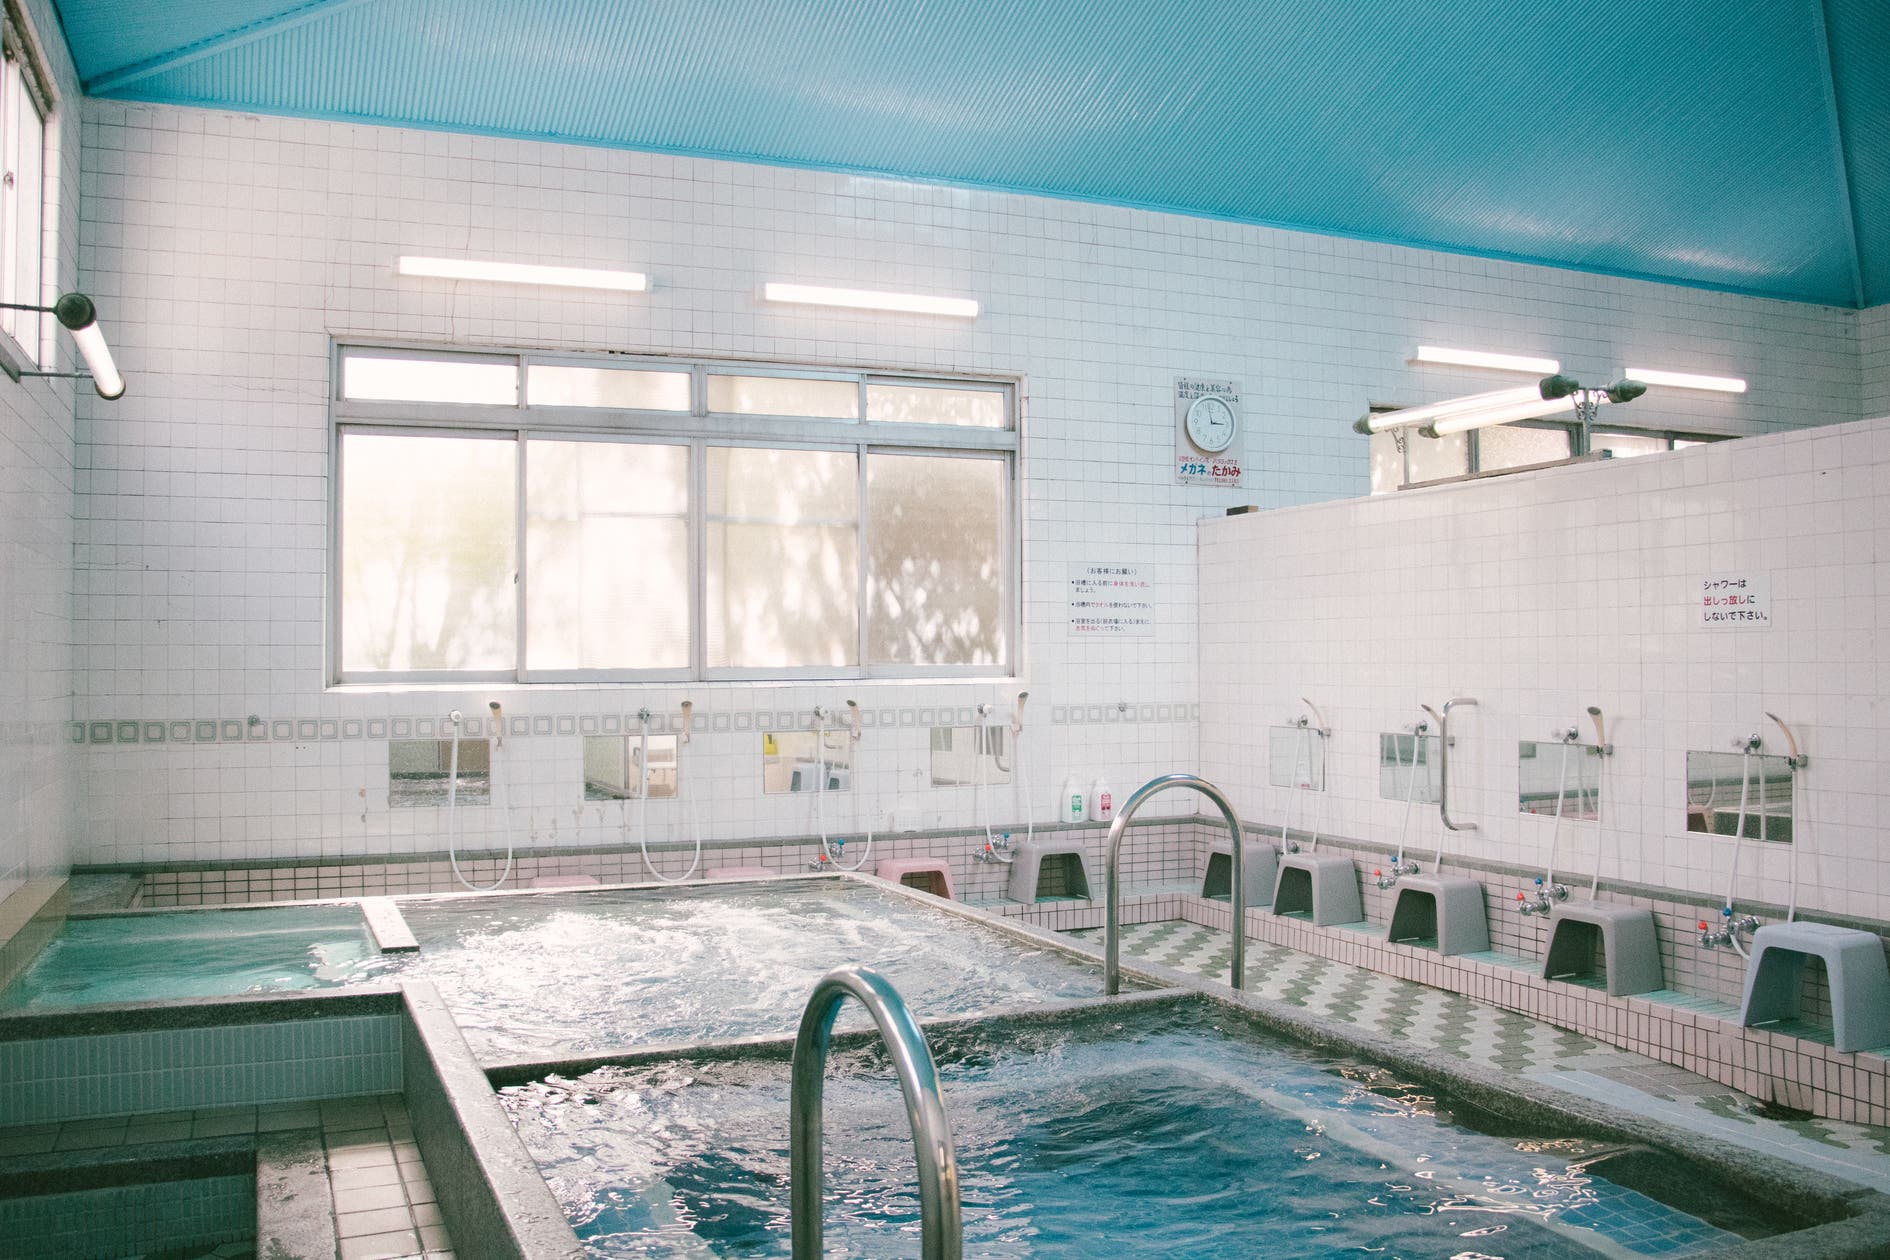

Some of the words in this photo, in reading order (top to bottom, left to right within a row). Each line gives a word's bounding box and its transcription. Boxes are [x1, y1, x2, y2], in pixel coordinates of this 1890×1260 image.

[1704, 579, 1747, 590] シャワーは
[1704, 595, 1755, 606] 出しっ放しに
[1704, 611, 1768, 621] しないで下さい。
